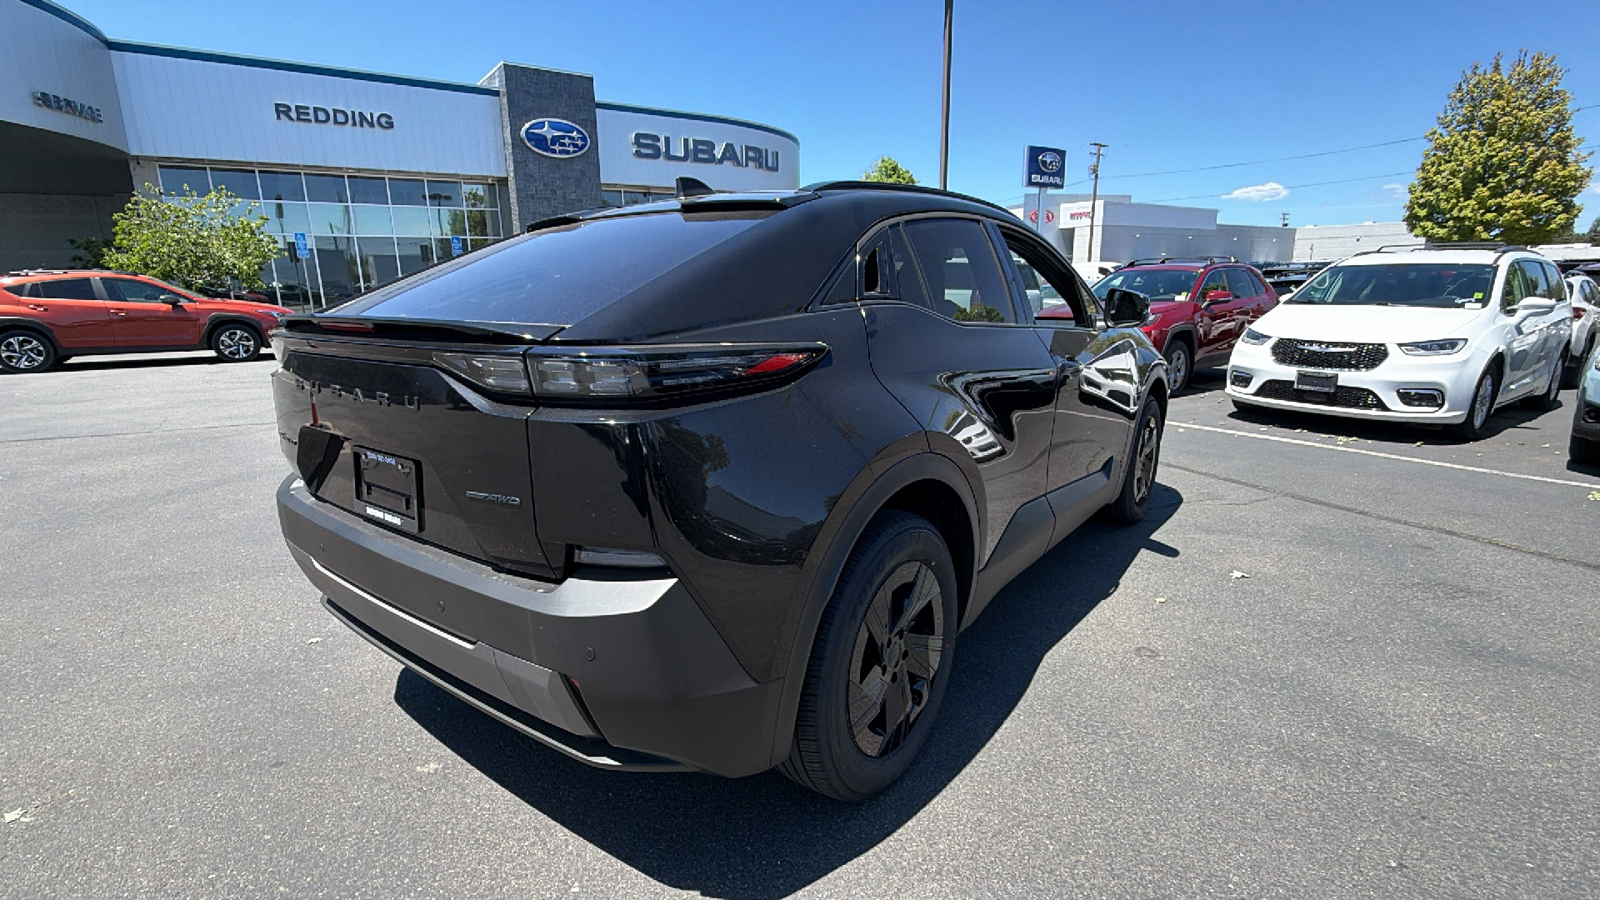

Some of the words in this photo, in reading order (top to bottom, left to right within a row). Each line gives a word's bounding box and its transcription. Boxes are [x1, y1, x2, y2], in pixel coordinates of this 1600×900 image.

[32, 91, 104, 123] SERVICE
[274, 103, 394, 129] REDDING
[632, 132, 779, 172] SUBARU
[1031, 174, 1063, 185] SUBARU
[294, 378, 421, 411] SUBARU
